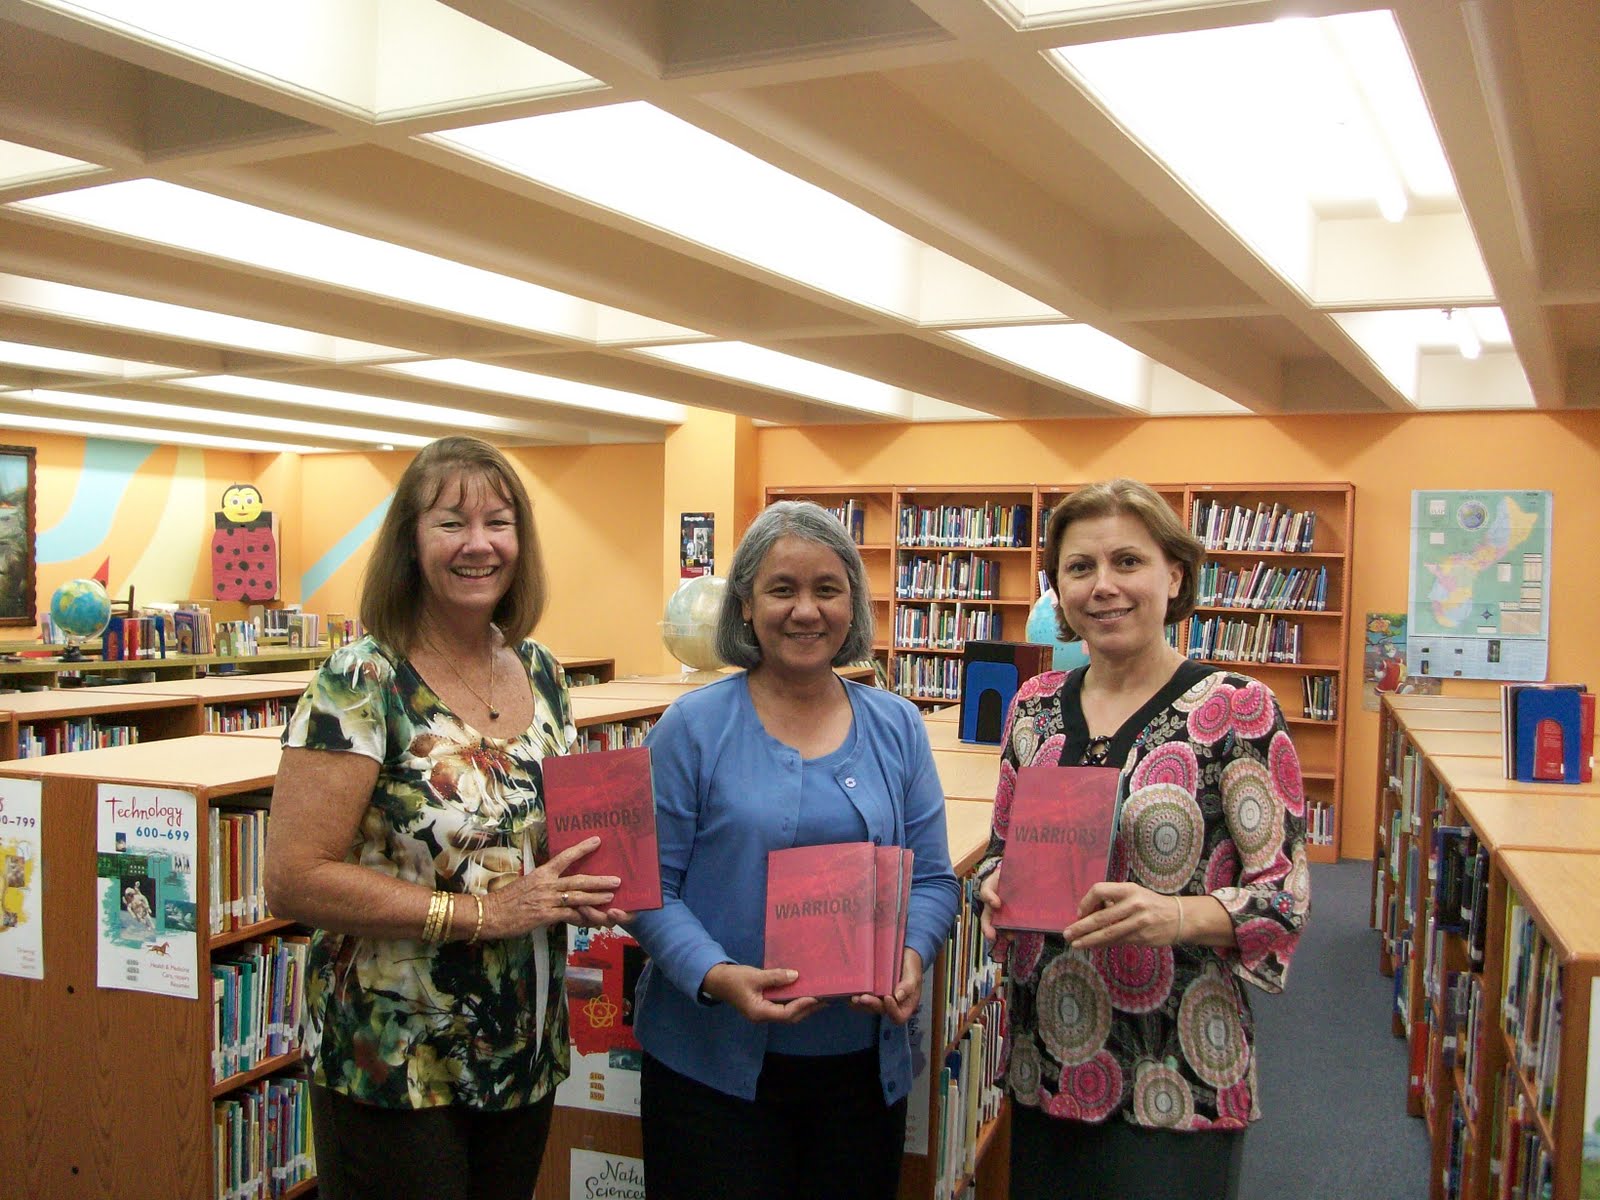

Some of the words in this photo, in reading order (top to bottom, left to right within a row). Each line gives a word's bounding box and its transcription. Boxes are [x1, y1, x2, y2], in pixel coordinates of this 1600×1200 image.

[0, 815, 35, 828] 0-799
[105, 796, 183, 827] Technology
[554, 807, 641, 832] WARRIORS
[136, 826, 189, 841] 600-699
[1015, 825, 1097, 845] WARRIORS
[775, 897, 863, 920] WARRIORS
[600, 1160, 645, 1186] Natu
